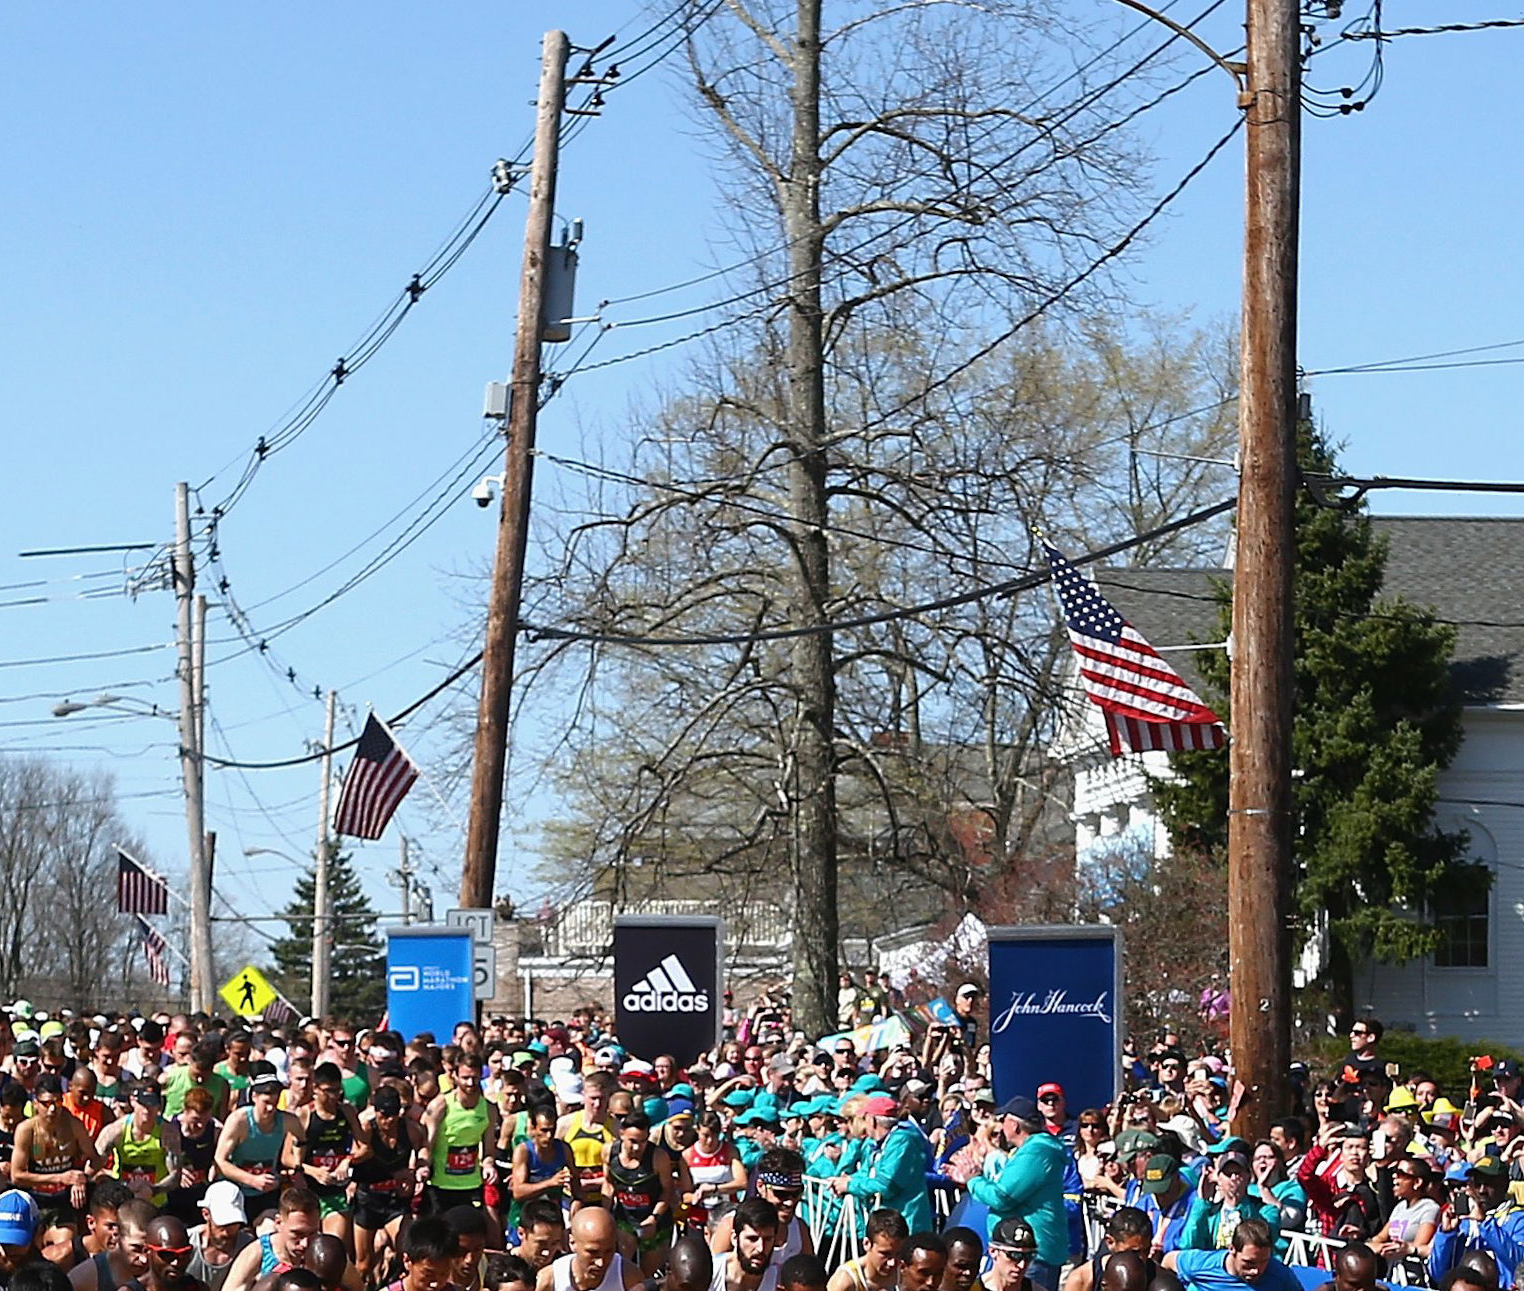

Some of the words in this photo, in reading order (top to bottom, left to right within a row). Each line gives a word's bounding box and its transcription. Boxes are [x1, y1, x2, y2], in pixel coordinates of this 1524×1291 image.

[623, 991, 708, 1013] adidas
[991, 990, 1048, 1034] John
[1043, 990, 1112, 1025] Hancock
[1259, 997, 1271, 1012] 2
